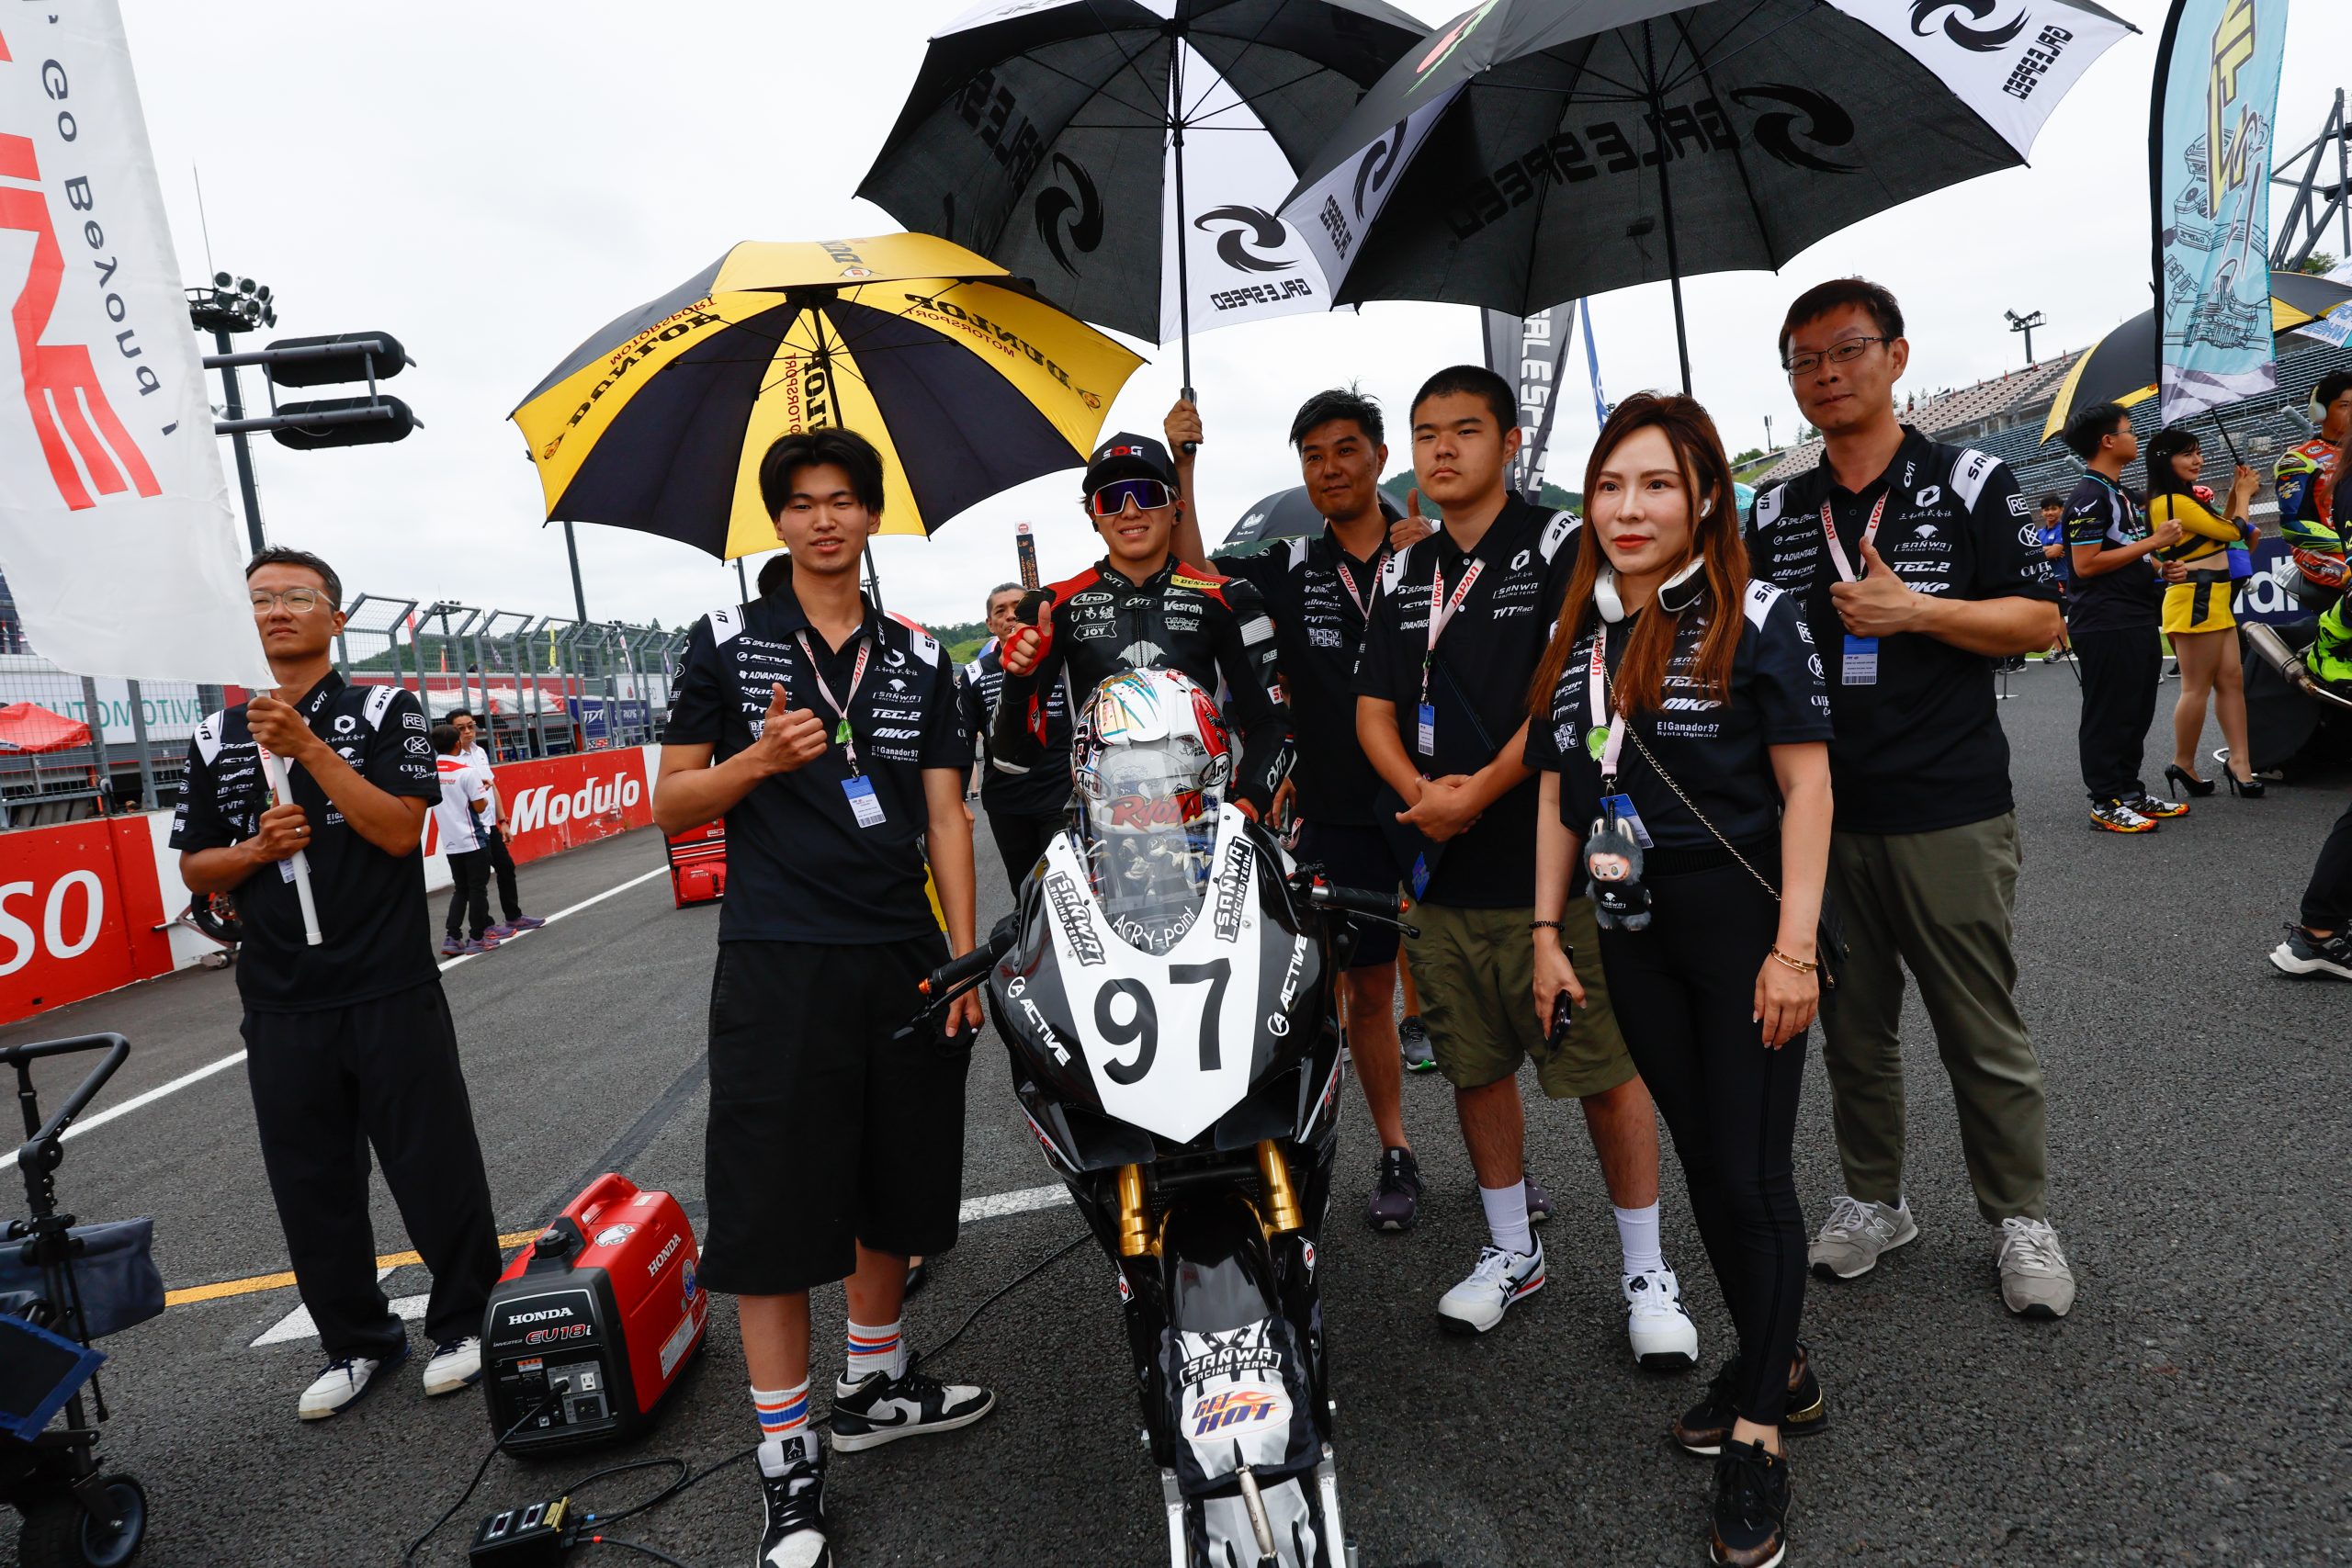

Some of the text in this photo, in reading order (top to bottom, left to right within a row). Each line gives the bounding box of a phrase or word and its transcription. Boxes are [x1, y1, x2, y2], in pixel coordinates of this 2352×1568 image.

[1552, 513, 1581, 542] SAN
[1785, 529, 1819, 542] ACTIVE
[1782, 546, 1819, 562] ADVANTAGE
[1901, 540, 1948, 549] SANWA
[1893, 561, 1951, 573] TEC.2
[1451, 566, 1479, 609] JAPAN
[1498, 582, 1539, 595] SANWA
[1163, 601, 1204, 615] Vesrah
[1083, 628, 1105, 637] JOY
[750, 653, 793, 665] ACTIVE
[749, 671, 793, 682] ADVANTAGE
[879, 692, 916, 701] SANWA
[1661, 697, 1722, 712] MKP
[37, 698, 204, 727] UTOMOTIVE
[872, 708, 922, 722] TEC.2
[872, 728, 921, 739] MKP
[400, 763, 427, 773] OVER
[510, 773, 640, 836] Modulo
[1217, 844, 1245, 926] SANWA
[1231, 852, 1252, 929] RACING TEAM
[1047, 887, 1085, 961] RACING TEAM
[1057, 878, 1102, 955] SANWA
[1280, 933, 1309, 1011] ACTIVE
[1019, 998, 1072, 1067] ACTIVE
[1093, 958, 1232, 1086] 97
[647, 1234, 682, 1278] HONDA
[508, 1307, 574, 1325] HONDA
[493, 1324, 592, 1348] INVERTER EU18i
[1188, 1347, 1273, 1376] SANWA
[1191, 1359, 1270, 1384] RACING TEAM
[1192, 1390, 1235, 1420] GET
[1194, 1401, 1276, 1438] HOT
